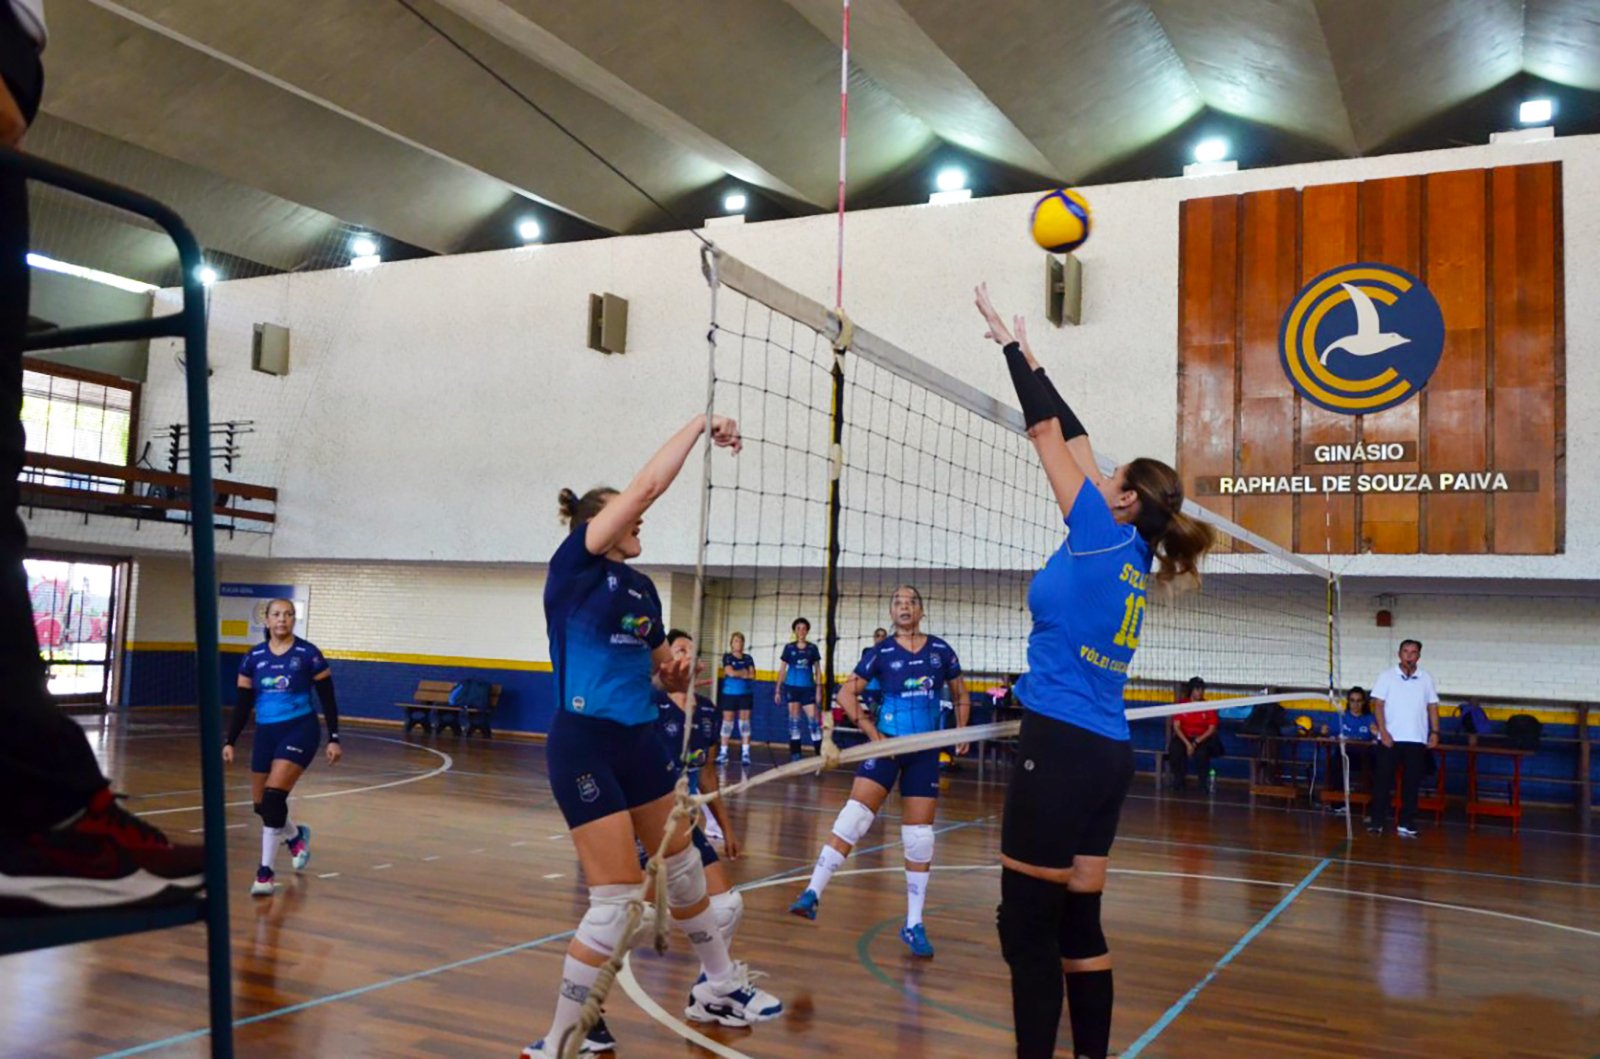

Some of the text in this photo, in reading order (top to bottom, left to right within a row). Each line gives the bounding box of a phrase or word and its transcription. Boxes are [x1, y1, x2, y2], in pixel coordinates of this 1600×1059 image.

[1314, 442, 1404, 462] GINÁSIO
[1219, 472, 1509, 494] RAPHAEL DE SOUZA PAIVA
[1112, 591, 1146, 649] 10
